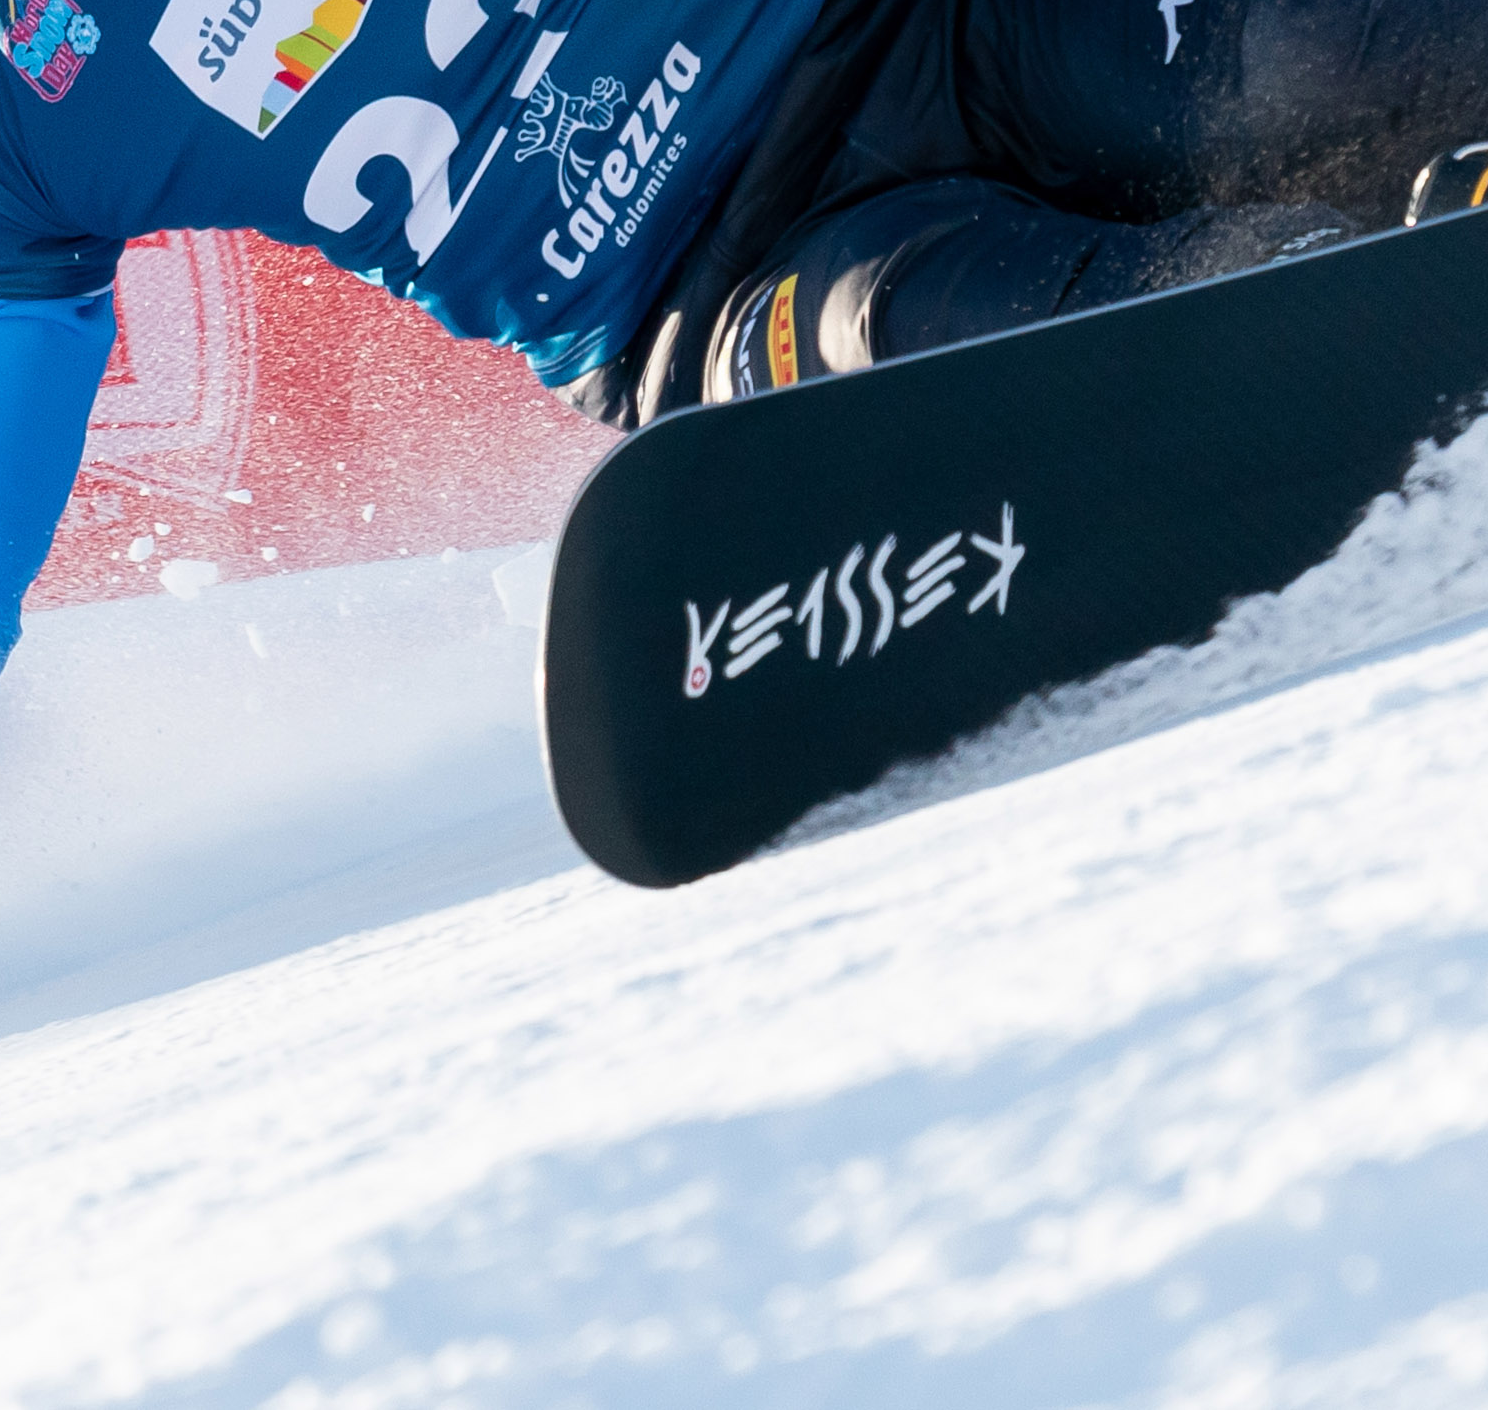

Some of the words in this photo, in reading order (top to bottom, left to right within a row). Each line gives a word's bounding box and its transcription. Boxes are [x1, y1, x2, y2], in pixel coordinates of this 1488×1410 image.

[41, 40, 79, 91] Day
[541, 40, 701, 280] Carezza
[614, 131, 688, 248] dolomites
